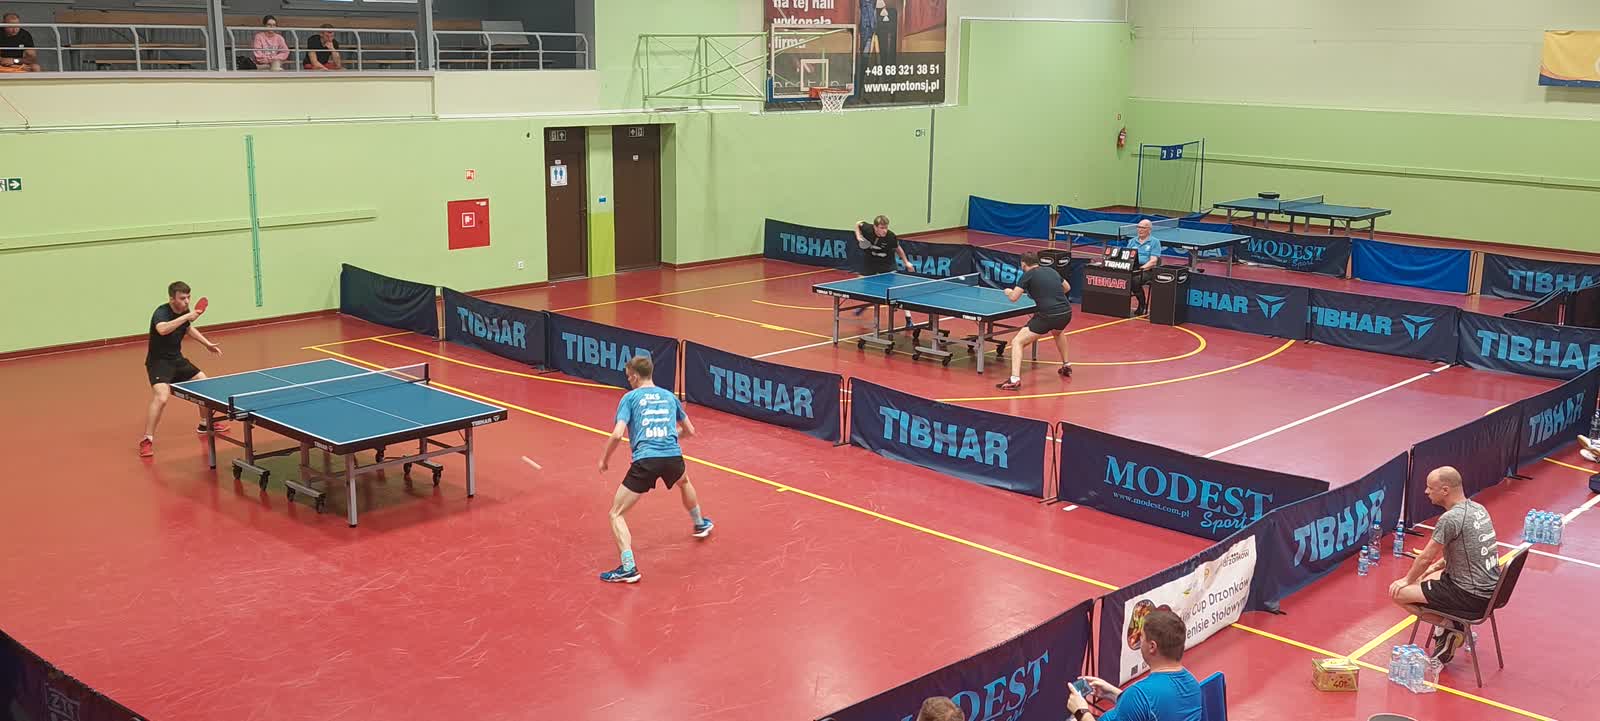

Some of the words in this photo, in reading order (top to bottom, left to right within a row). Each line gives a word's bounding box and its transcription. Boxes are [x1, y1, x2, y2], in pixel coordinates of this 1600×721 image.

[865, 65, 882, 76] +48
[885, 65, 896, 76] 68
[898, 64, 914, 75] 321
[917, 64, 928, 75] 38
[929, 64, 939, 74] 51
[864, 79, 939, 94] www.protonsj.pl
[779, 232, 847, 259] TIBHAR
[1121, 250, 1130, 260] 10
[1247, 238, 1326, 260] MODEST
[980, 260, 1024, 285] TIB
[1104, 260, 1130, 271] TIBHAR
[1086, 275, 1127, 290] TIBHAR
[1508, 269, 1594, 292] TIBHA
[1187, 289, 1249, 314] BHAR
[457, 306, 526, 349] TIBHAR
[562, 332, 653, 373] TIBHA
[710, 365, 815, 419] TIBHAR
[1528, 393, 1585, 447] TIBHAR
[879, 405, 1009, 469] TIBHAR
[1104, 455, 1273, 522] MODEST
[1113, 492, 1190, 519] www.modest.com.pl
[1200, 510, 1249, 534] Sport
[1294, 487, 1385, 568] TIBHAR
[1191, 600, 1207, 617] Cup
[901, 650, 1049, 721] DEST
